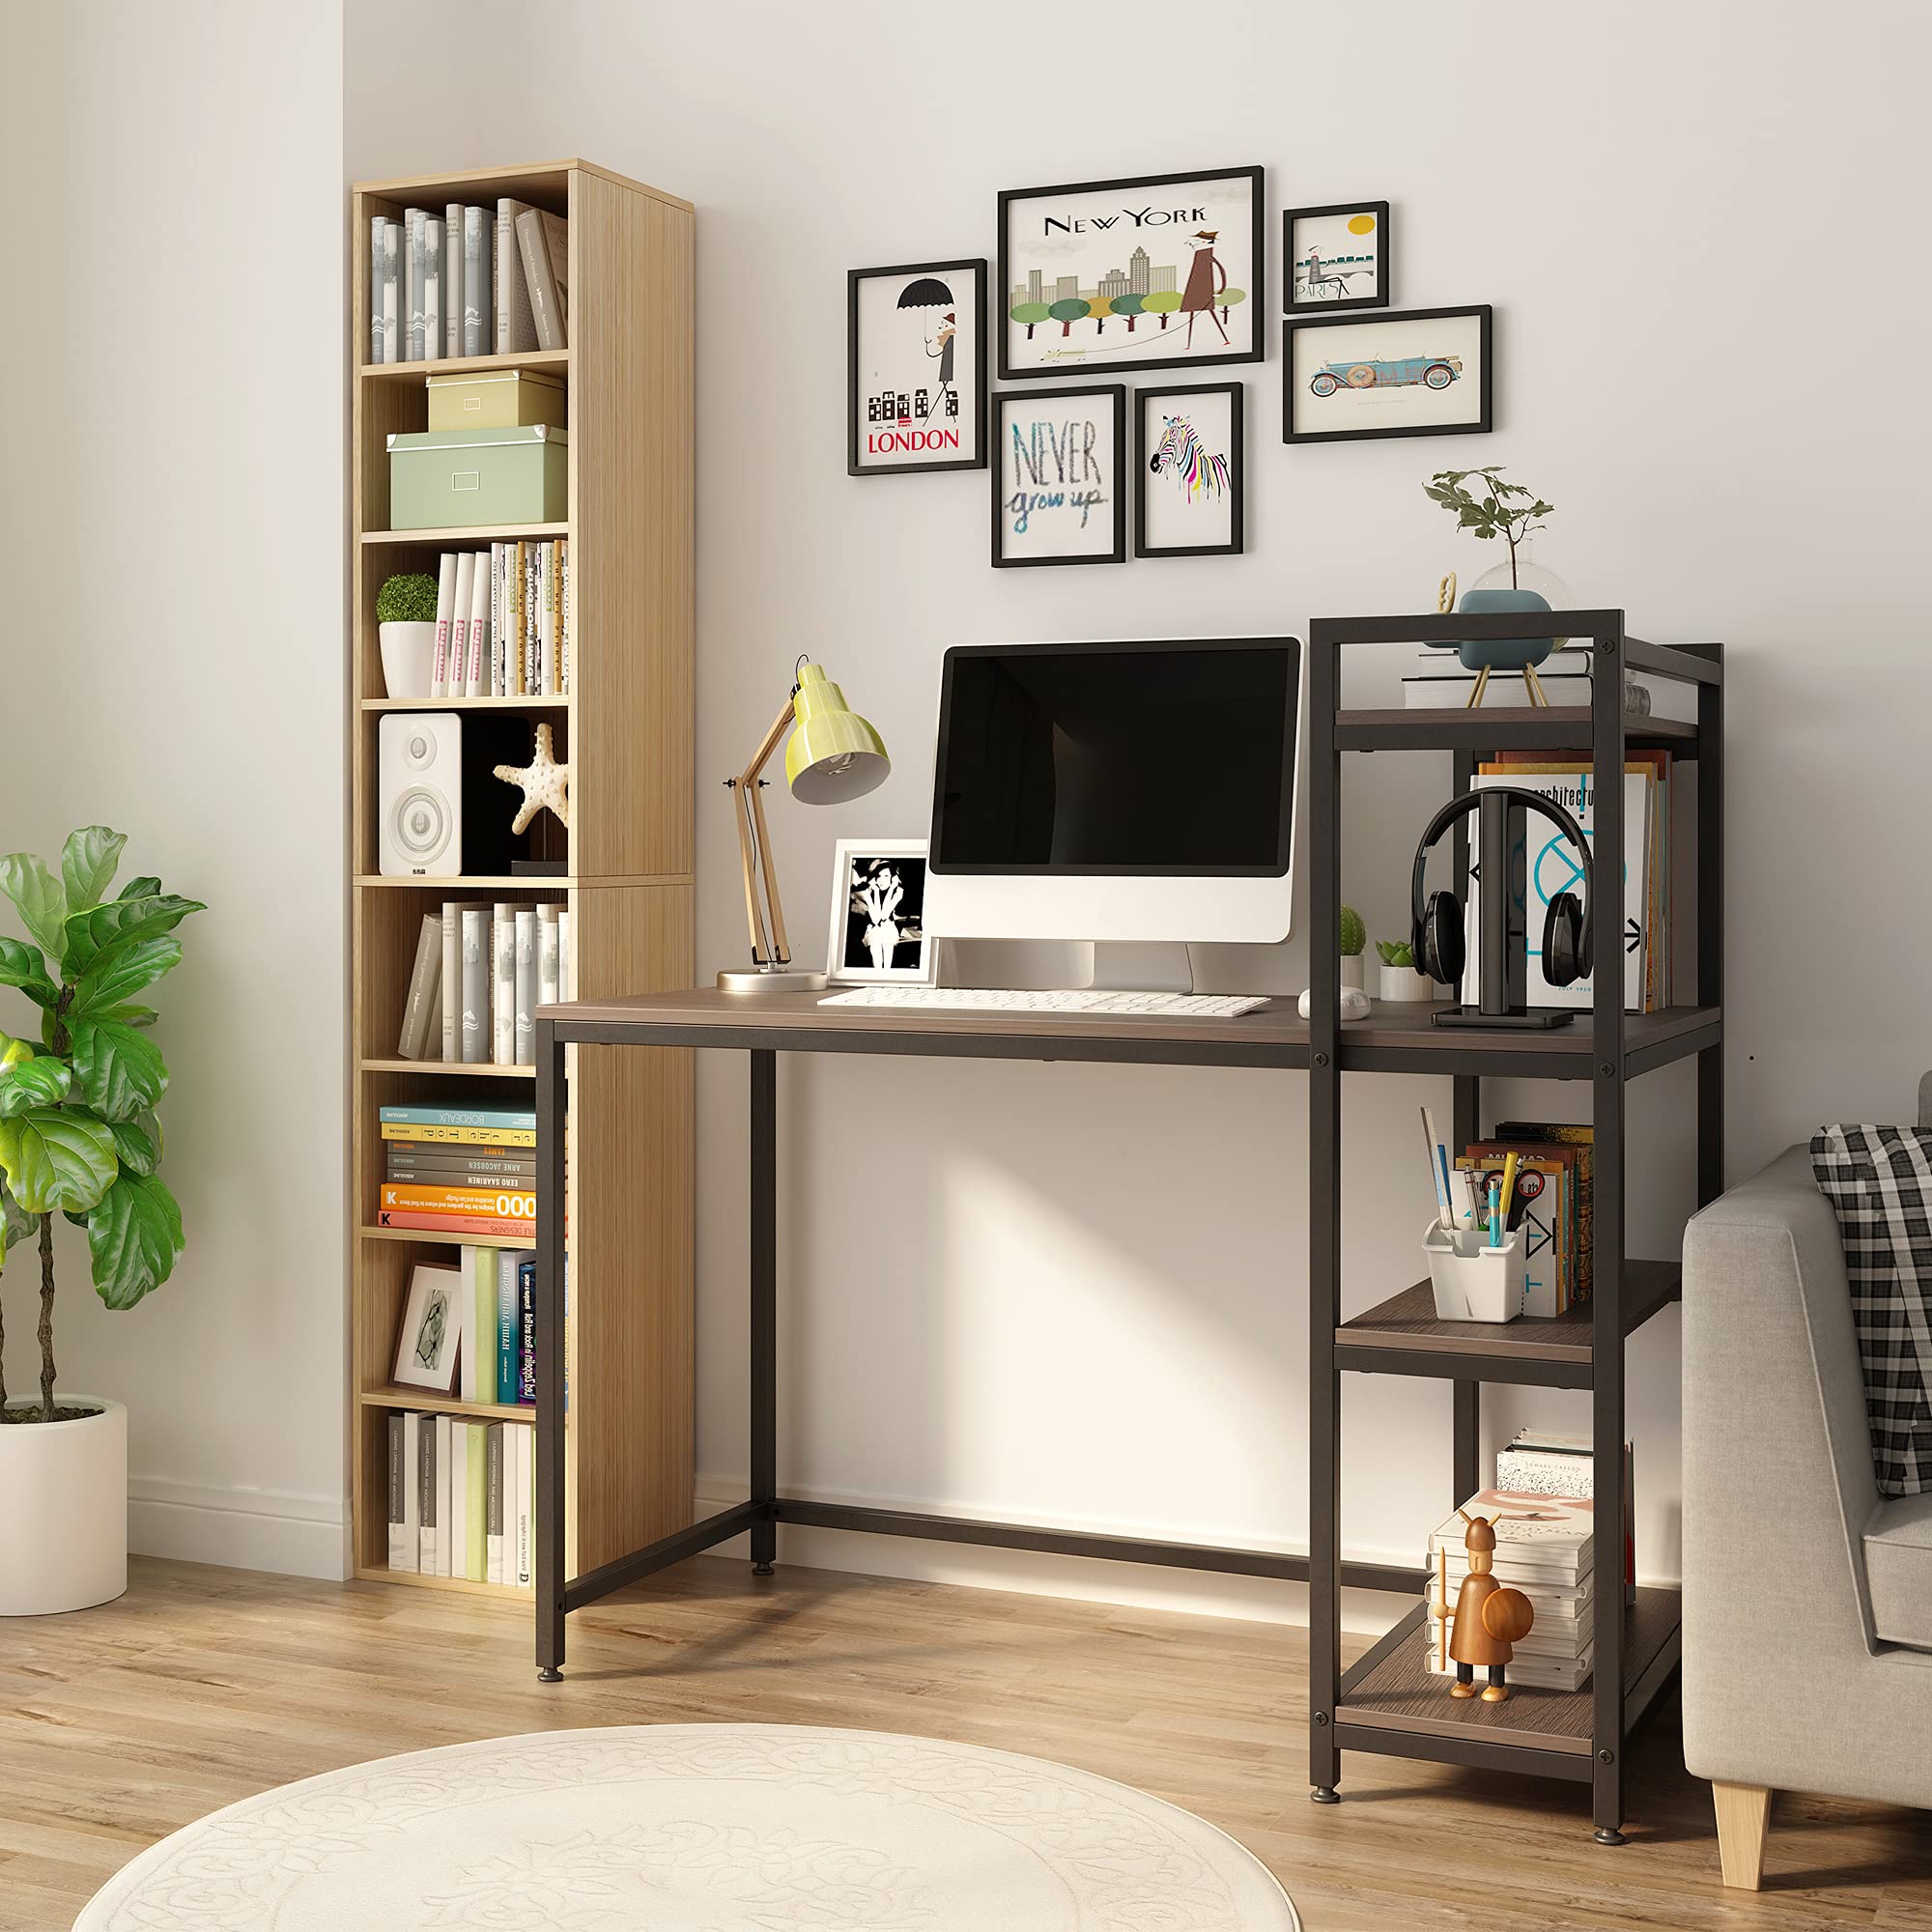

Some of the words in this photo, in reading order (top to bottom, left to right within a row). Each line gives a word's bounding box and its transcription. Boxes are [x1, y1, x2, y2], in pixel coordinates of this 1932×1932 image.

[1122, 206, 1208, 228] YORK
[867, 428, 960, 454] LONDON
[1011, 419, 1102, 487] NEVER
[1005, 491, 1066, 534] grow
[1069, 488, 1110, 529] up
[439, 1112, 485, 1124] BORDEAUX
[483, 1147, 505, 1155] EAMES
[469, 1161, 501, 1172] JACOBSEN
[503, 1163, 521, 1172] ARNE
[468, 1177, 500, 1186] SAARINEN
[501, 1179, 519, 1187] EERO
[385, 1191, 397, 1205] K
[382, 1212, 390, 1225] K
[490, 1226, 523, 1235] DESIGNERS
[519, 1573, 528, 1582] D
